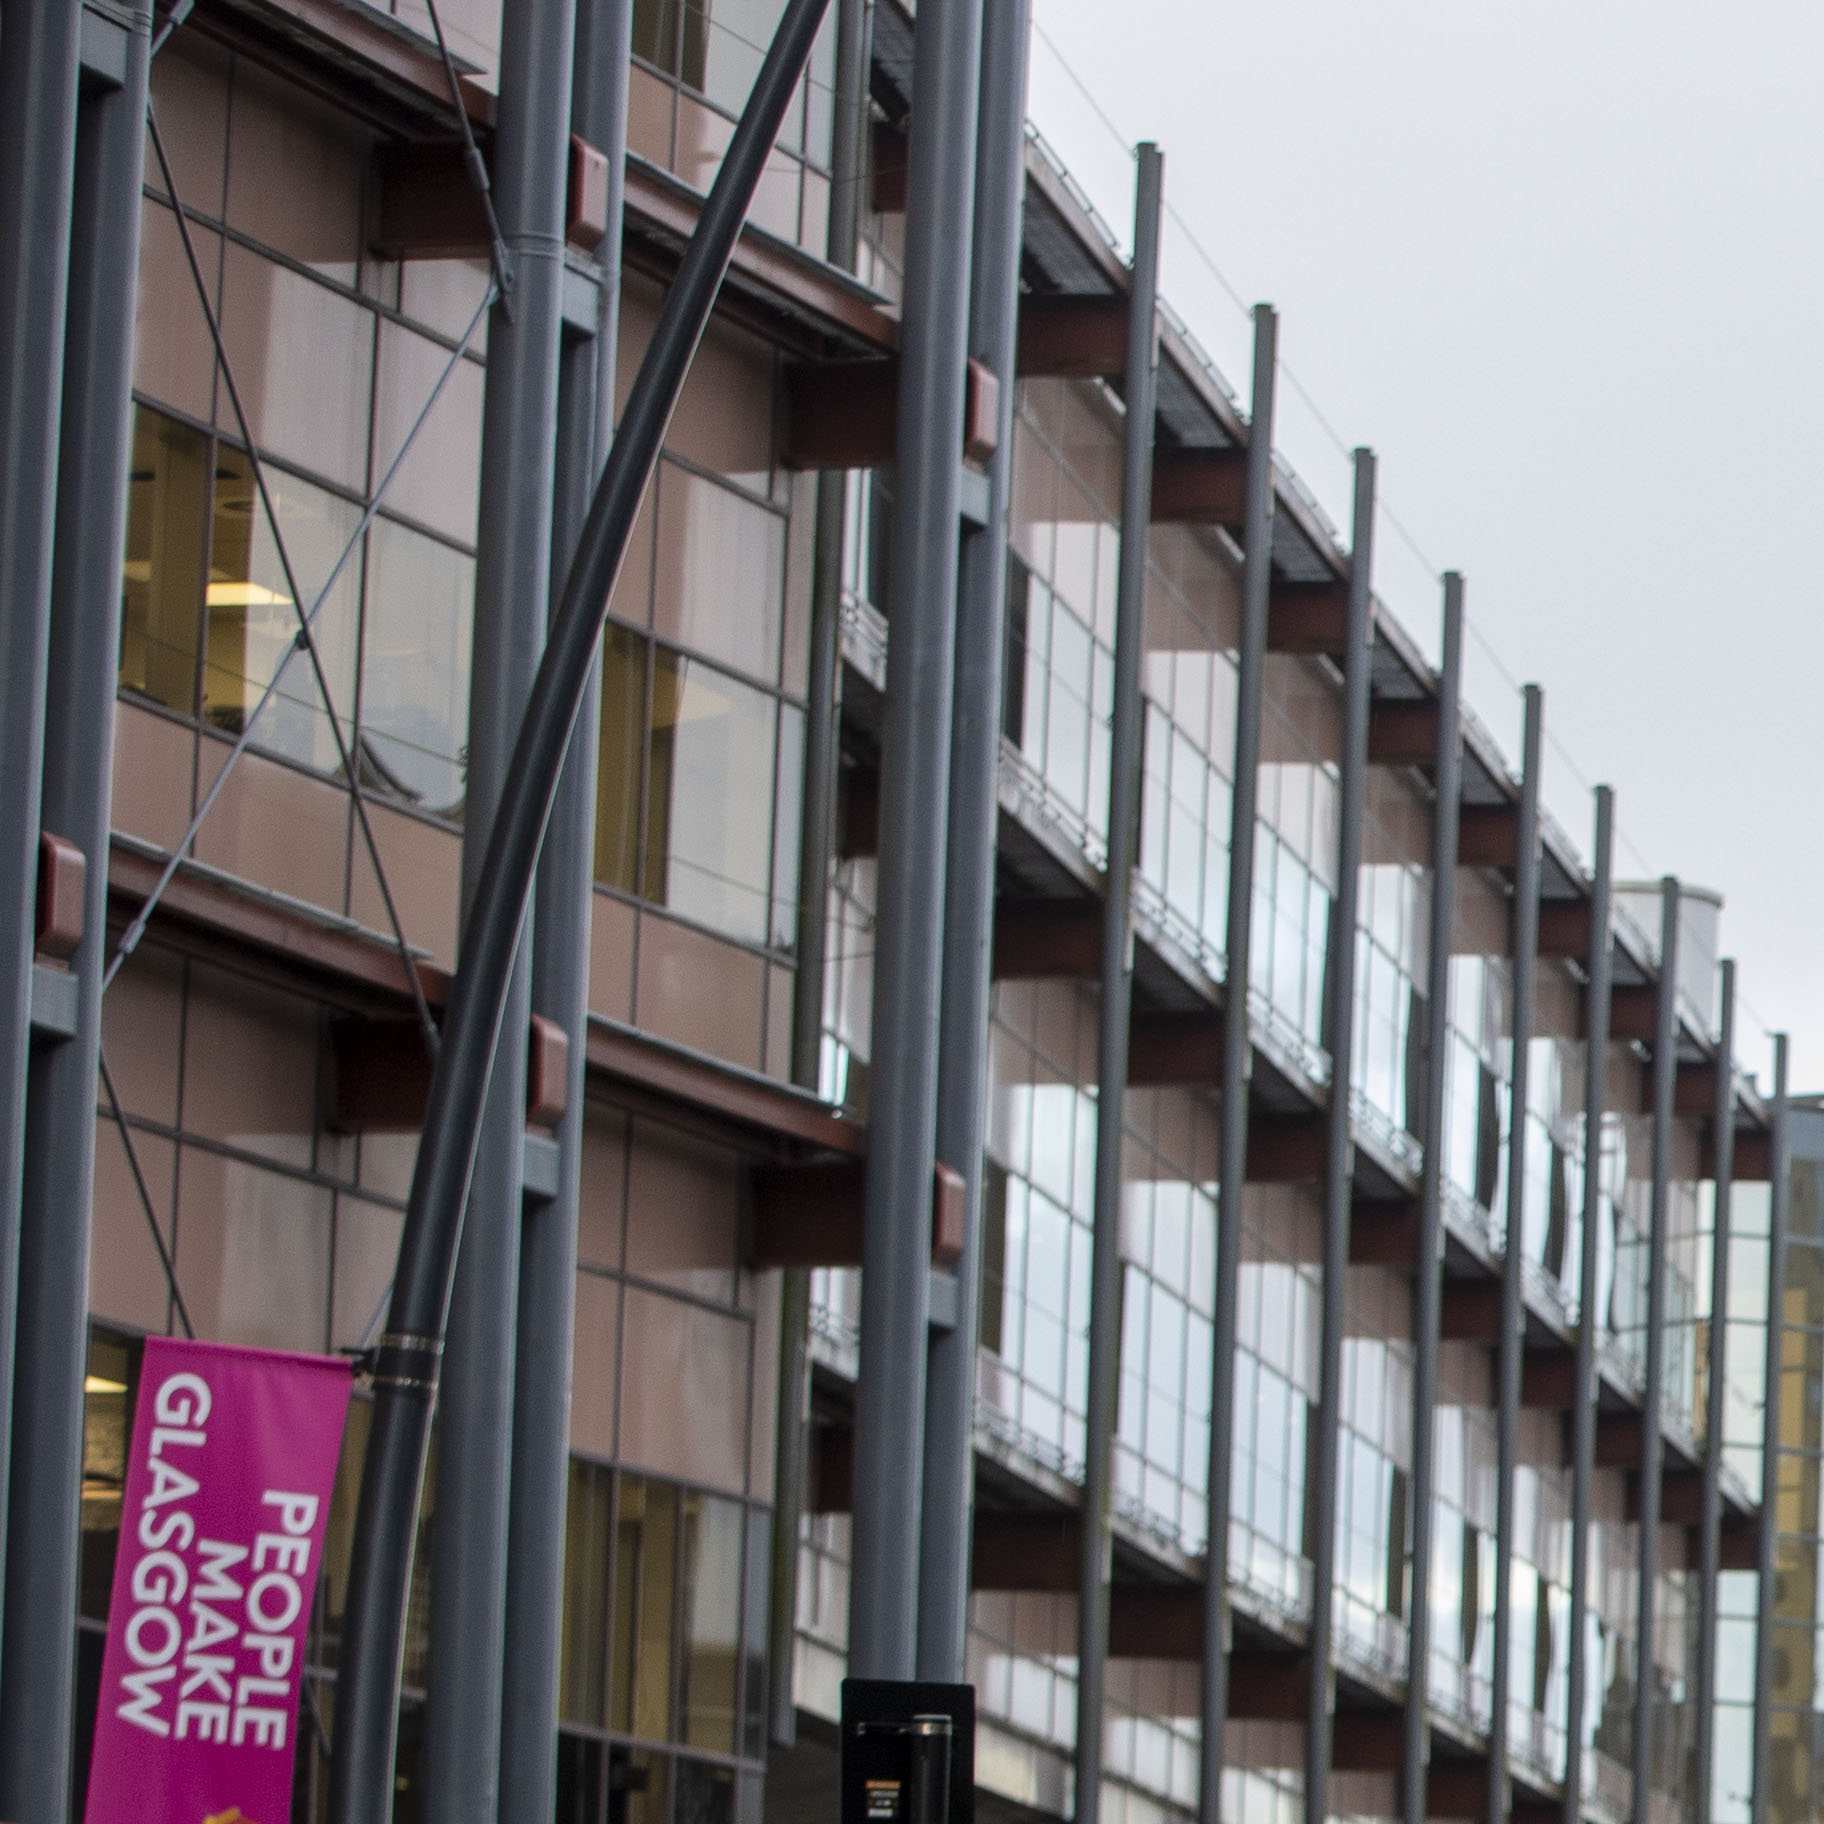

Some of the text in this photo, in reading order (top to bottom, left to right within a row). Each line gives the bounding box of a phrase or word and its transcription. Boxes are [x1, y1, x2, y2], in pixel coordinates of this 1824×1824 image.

[116, 1372, 212, 1738] GLASGOW
[175, 1539, 248, 1747] MAKE
[231, 1489, 319, 1750] PEOPLE
